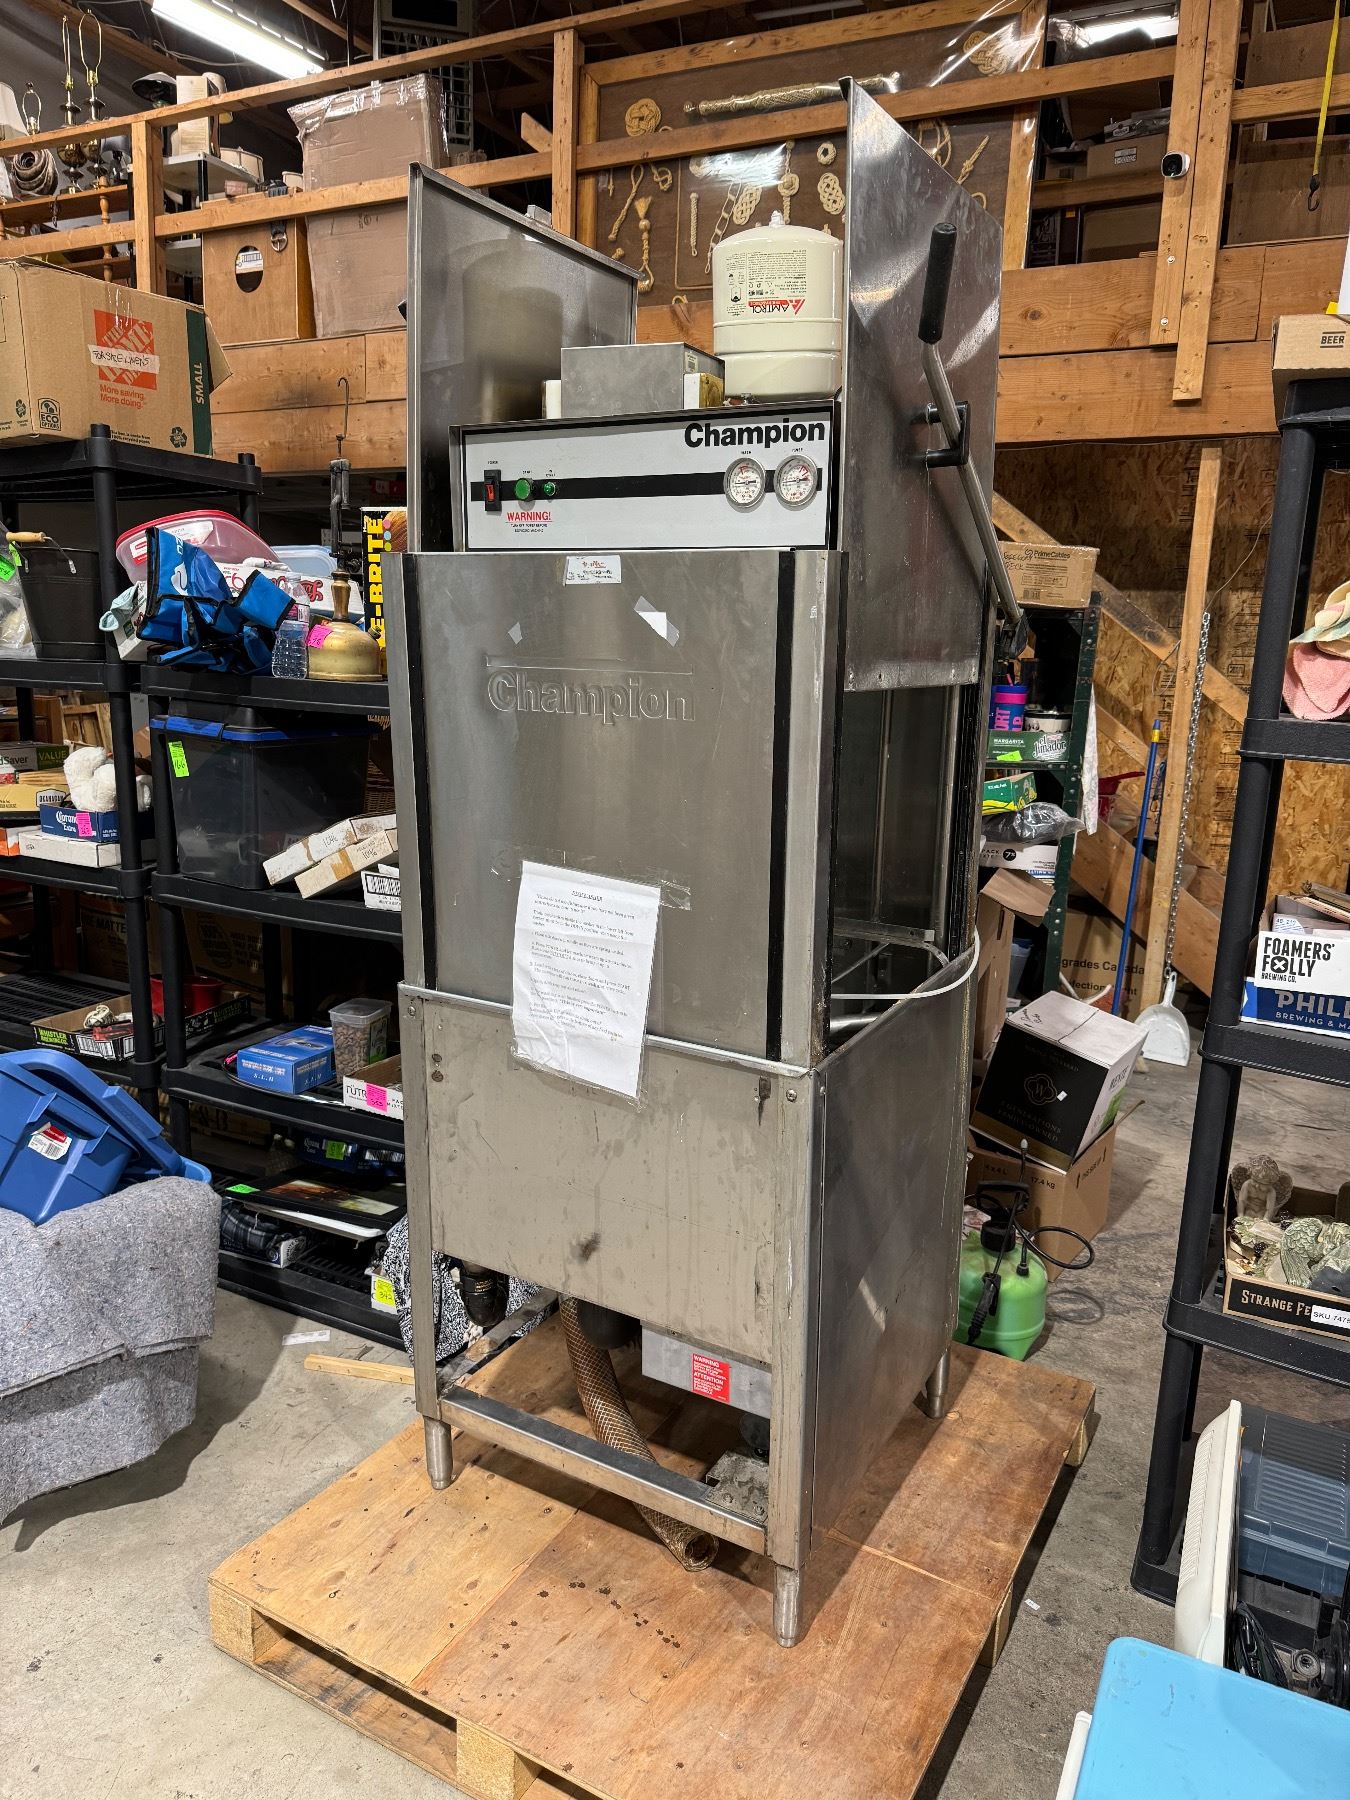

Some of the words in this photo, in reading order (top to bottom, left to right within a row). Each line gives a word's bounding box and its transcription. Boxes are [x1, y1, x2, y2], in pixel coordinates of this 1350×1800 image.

[752, 304, 790, 314] AMTROL
[1320, 335, 1345, 345] BEER
[196, 362, 205, 405] SMALL
[100, 384, 119, 396] More
[100, 394, 119, 405] More
[121, 397, 144, 410] doing.
[41, 413, 59, 424] ECO
[684, 417, 826, 449] Champion
[507, 511, 552, 522] WARNING!
[1033, 550, 1071, 559] PrimeCables
[488, 670, 696, 726] Champion
[38, 750, 67, 761] VALUE
[56, 810, 77, 824] Coron
[1102, 961, 1145, 975] Caada
[1261, 972, 1287, 982] BREWING
[1275, 1011, 1323, 1026] BREWING
[39, 1028, 67, 1040] WHISTLER
[1031, 1176, 1045, 1185] 17.4
[1046, 1181, 1056, 1190] kg
[1241, 1289, 1294, 1312] STRANGE
[1313, 1311, 1331, 1320] SKU
[694, 1355, 719, 1367] WARNING
[694, 1372, 724, 1385] ATTENTION
